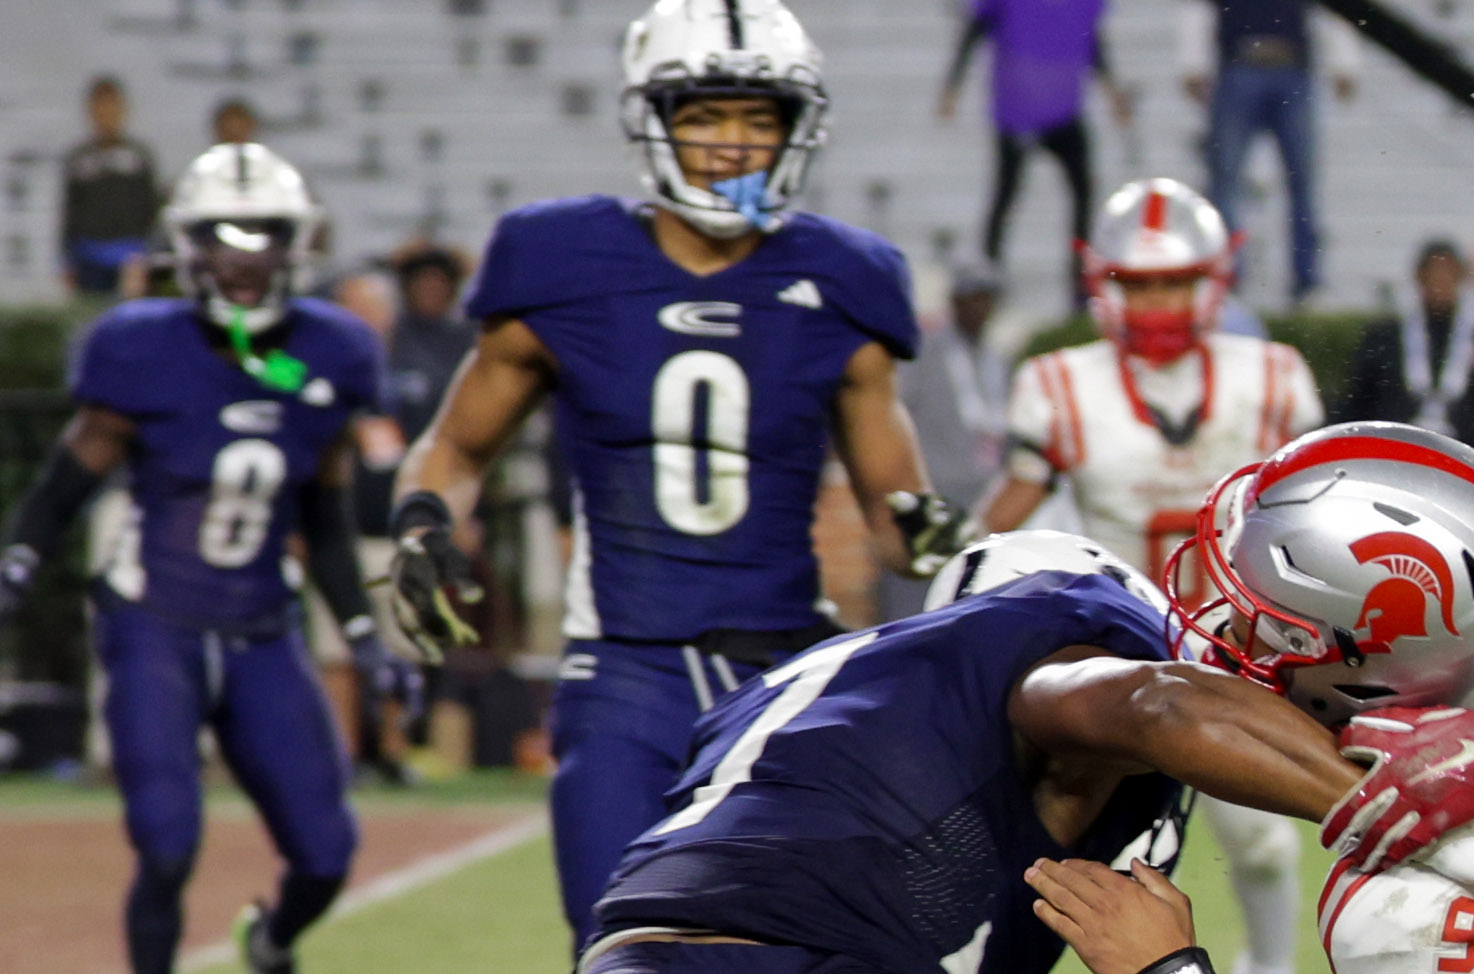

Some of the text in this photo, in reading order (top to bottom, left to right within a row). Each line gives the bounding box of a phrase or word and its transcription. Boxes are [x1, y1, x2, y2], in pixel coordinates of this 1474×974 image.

[199, 438, 286, 569] 8
[653, 350, 749, 535] 0
[651, 632, 878, 836] 7
